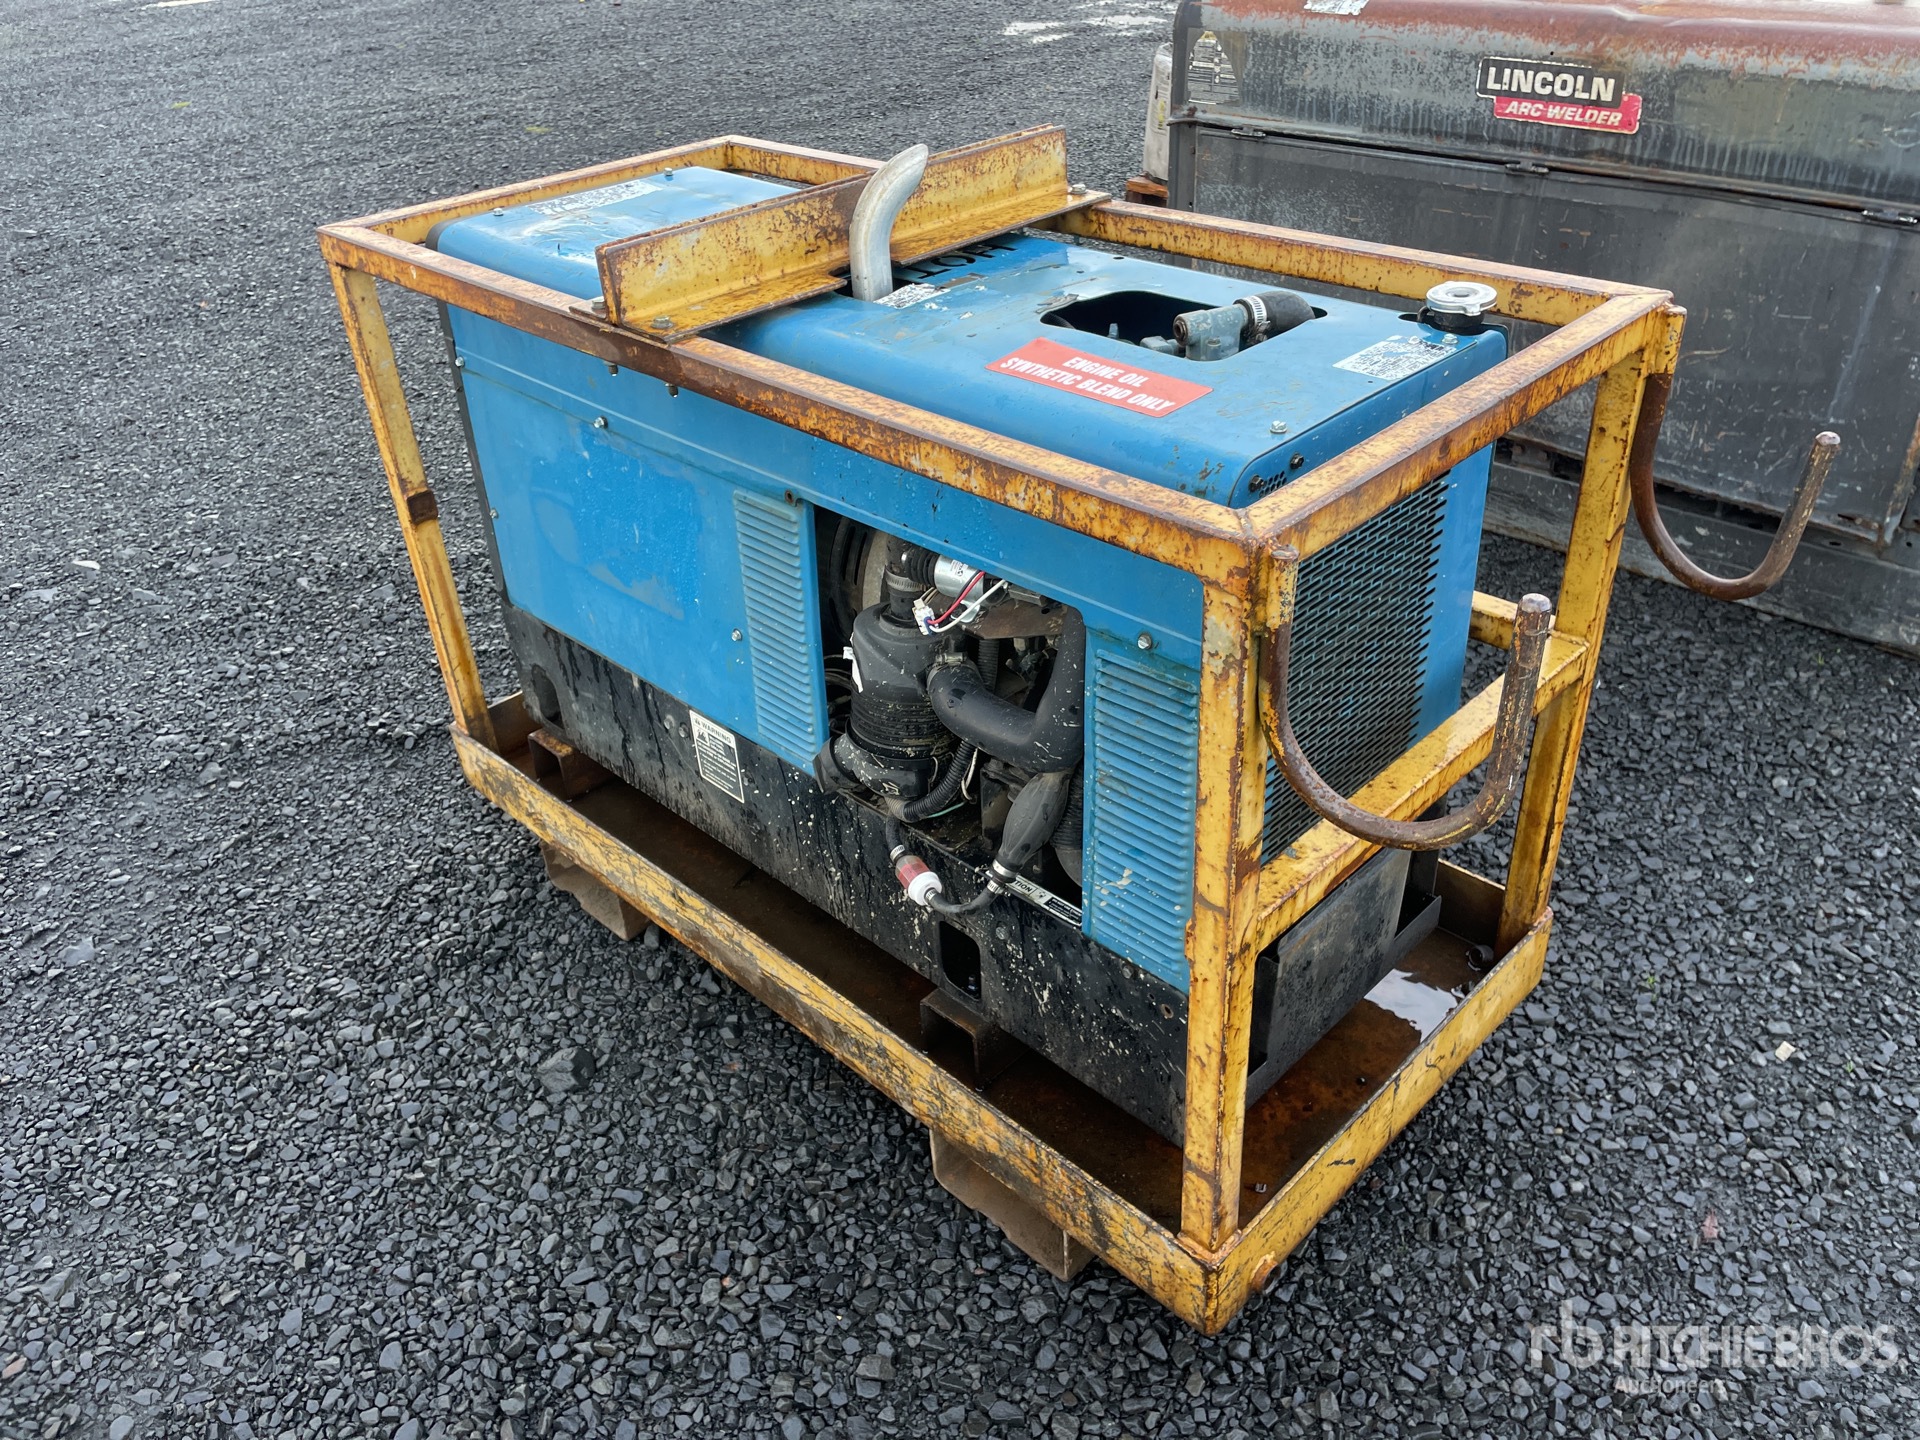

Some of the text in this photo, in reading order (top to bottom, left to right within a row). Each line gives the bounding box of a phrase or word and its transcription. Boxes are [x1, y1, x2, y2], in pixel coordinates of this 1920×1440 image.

[1486, 66, 1616, 102] LINCOLN
[1546, 105, 1622, 126] WELDER
[1000, 357, 1177, 411] SYNTHETIC BLEND ONLY
[1062, 357, 1150, 388] ENGINE OIL
[702, 722, 732, 744] WARNING
